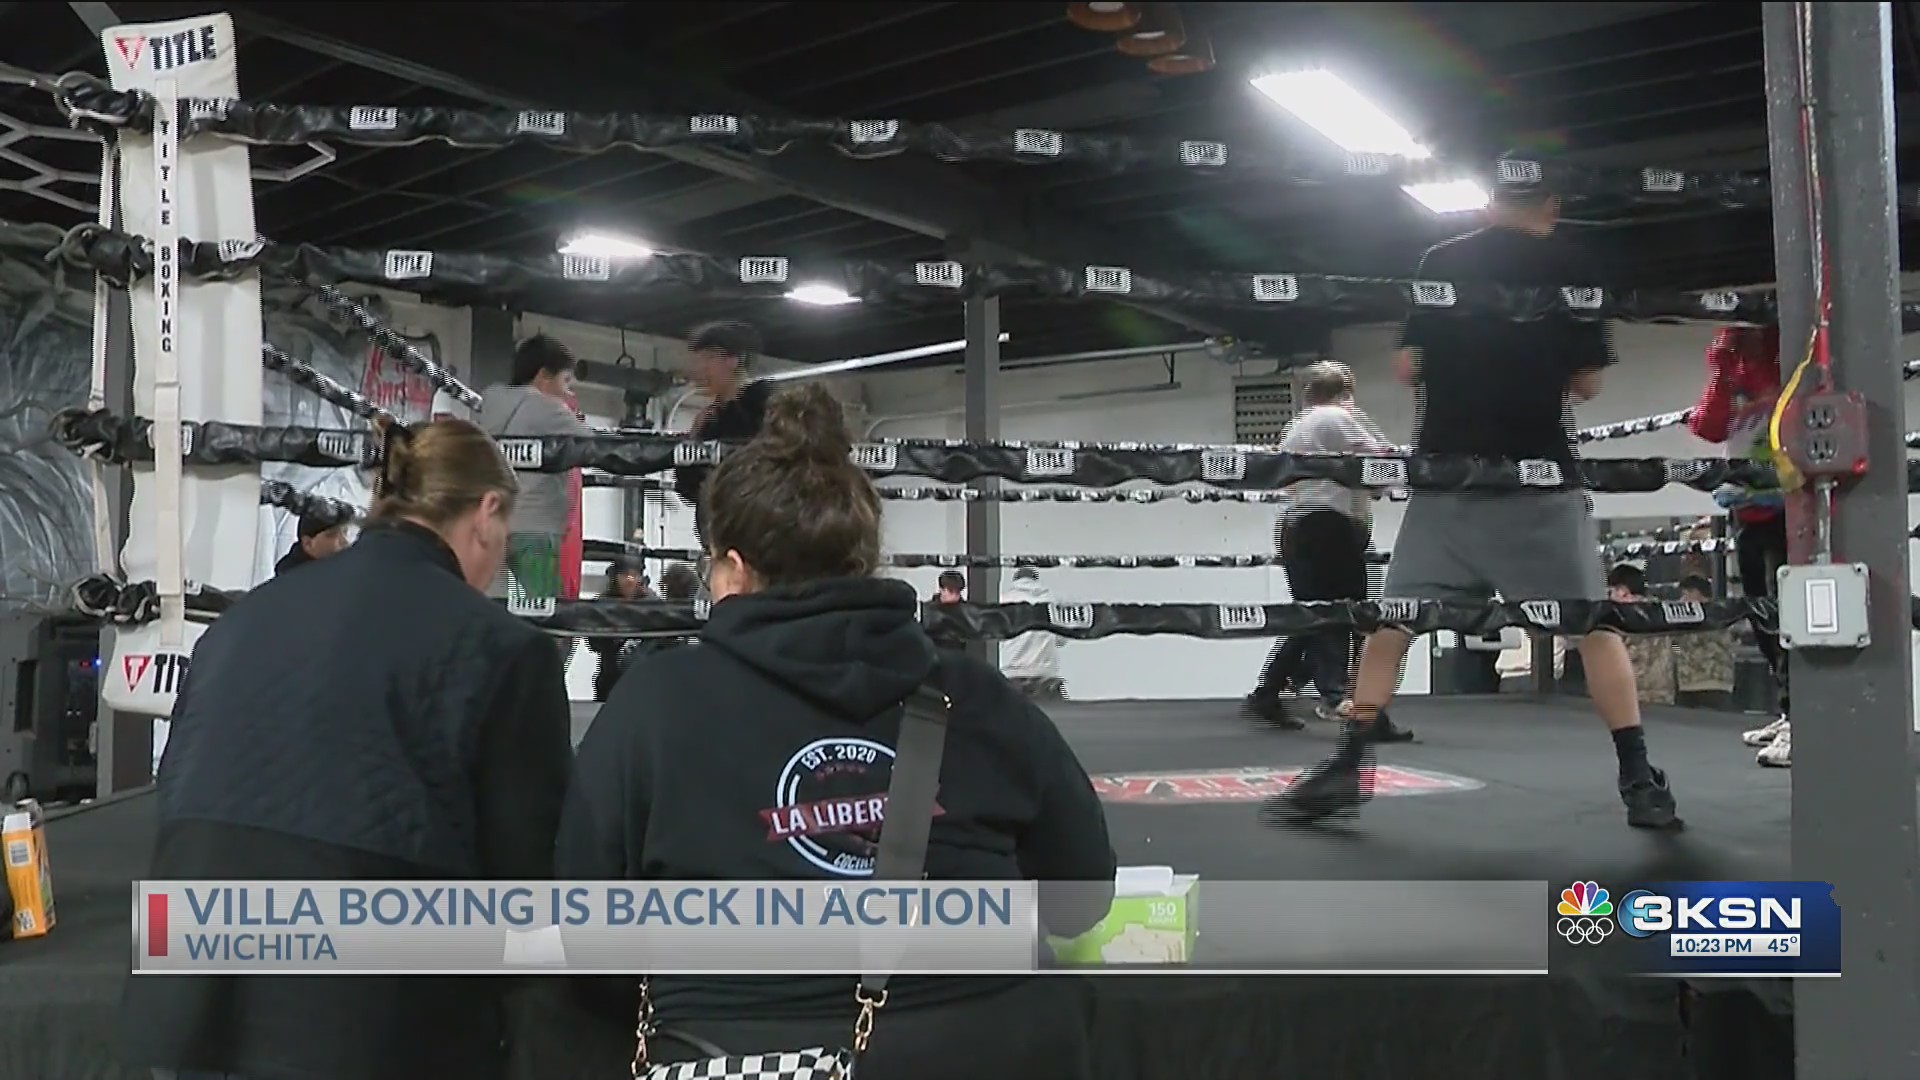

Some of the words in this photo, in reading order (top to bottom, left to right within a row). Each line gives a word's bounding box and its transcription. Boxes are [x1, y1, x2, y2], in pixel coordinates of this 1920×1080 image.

[148, 24, 217, 70] TITLE
[160, 120, 170, 225] TITLE
[160, 246, 172, 352] BOXING
[801, 748, 833, 771] EST.
[835, 745, 877, 764] 2020
[771, 809, 807, 834] LA
[813, 797, 888, 827] LIBER
[1149, 902, 1176, 916] 150
